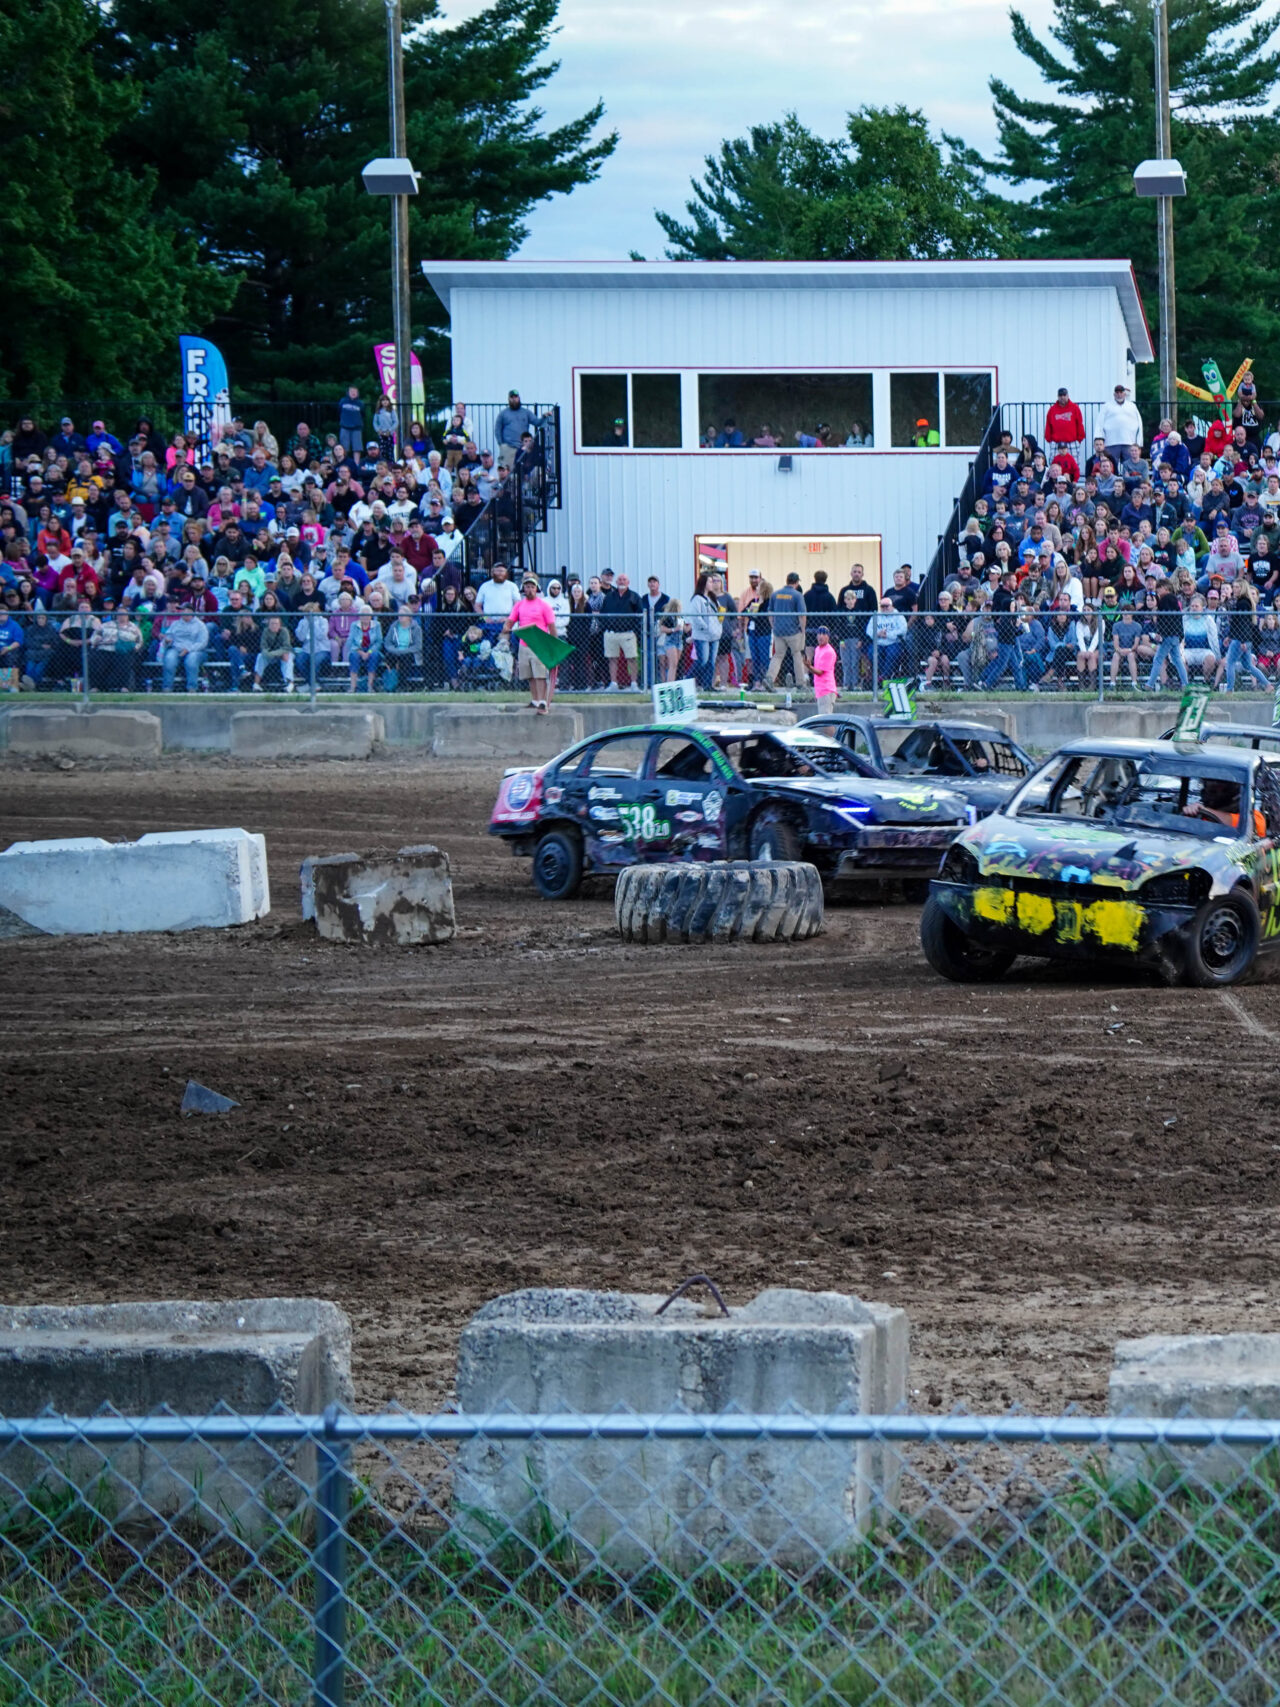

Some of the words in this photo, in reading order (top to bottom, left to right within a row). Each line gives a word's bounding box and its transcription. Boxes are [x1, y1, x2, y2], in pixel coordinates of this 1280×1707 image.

[808, 542, 822, 553] EXIT
[658, 685, 685, 717] 538
[889, 682, 911, 713] 11
[617, 803, 656, 842] 538
